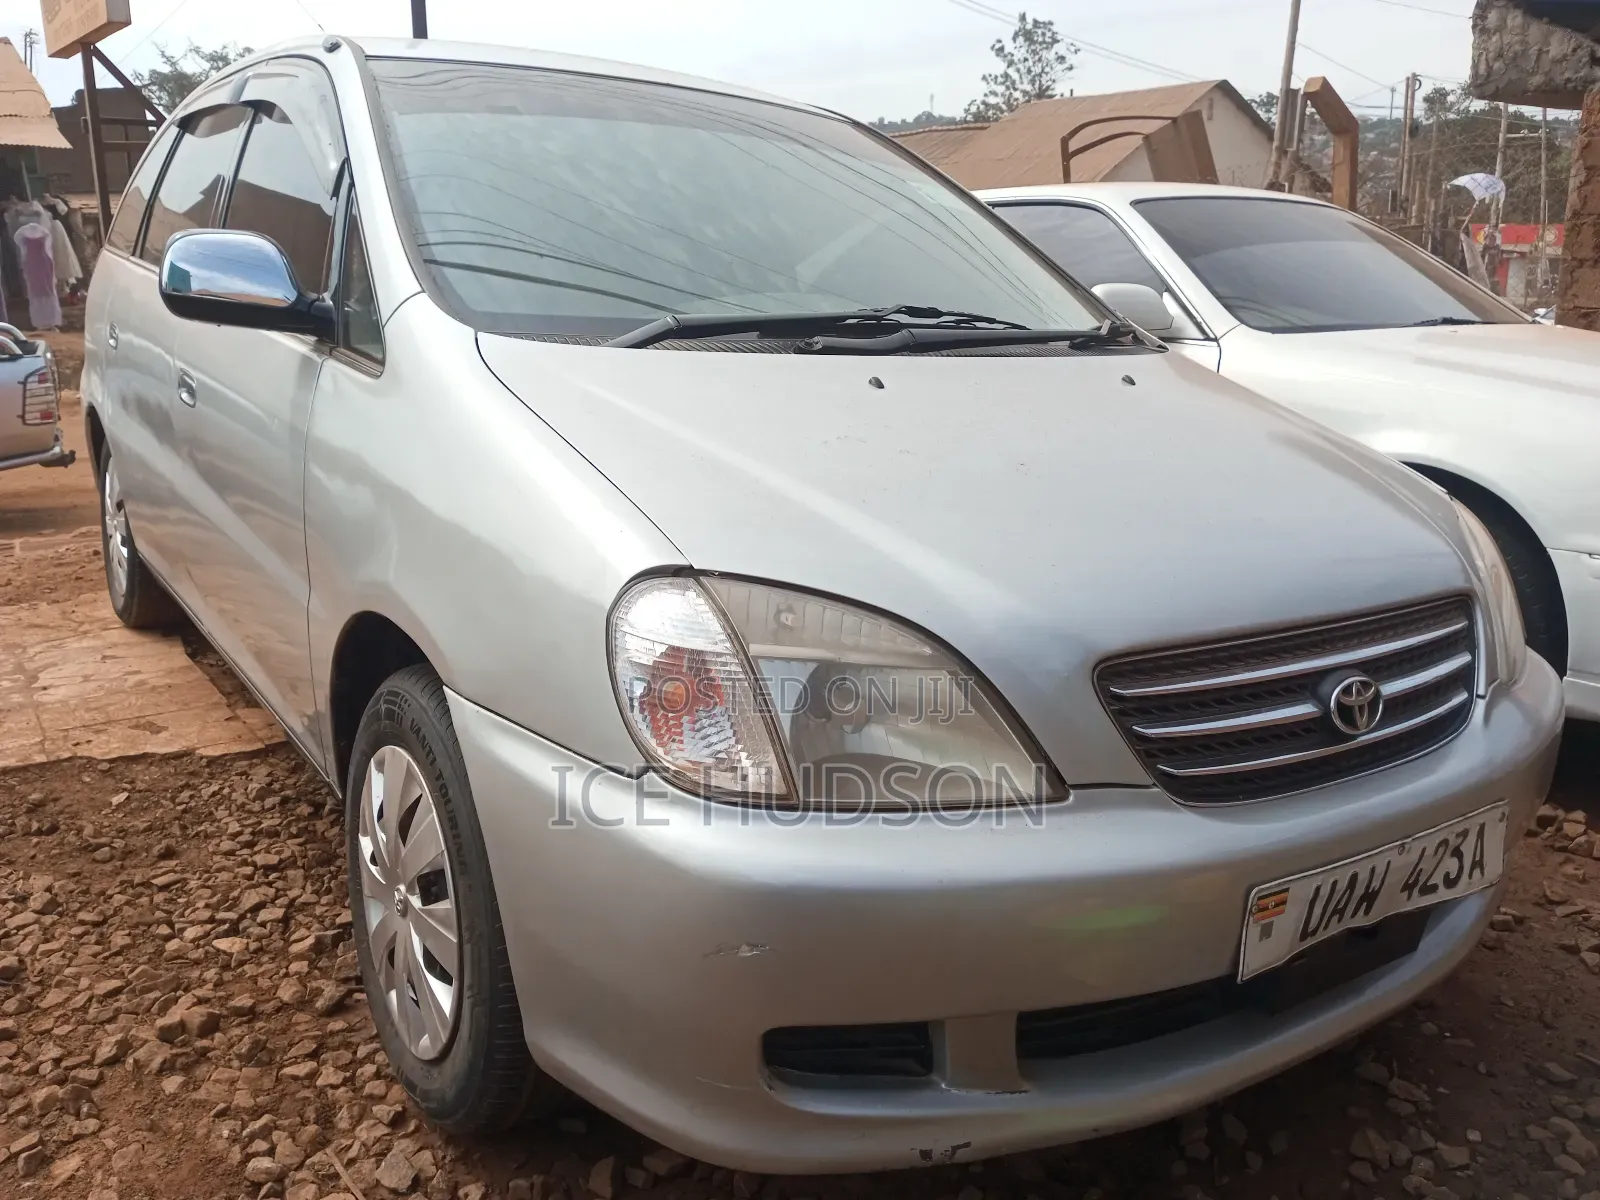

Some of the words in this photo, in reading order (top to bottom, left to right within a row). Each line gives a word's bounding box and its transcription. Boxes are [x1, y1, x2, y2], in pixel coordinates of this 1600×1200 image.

[409, 717, 437, 767] VANTI
[1299, 859, 1391, 942] UAW
[1400, 822, 1486, 901] 423A
